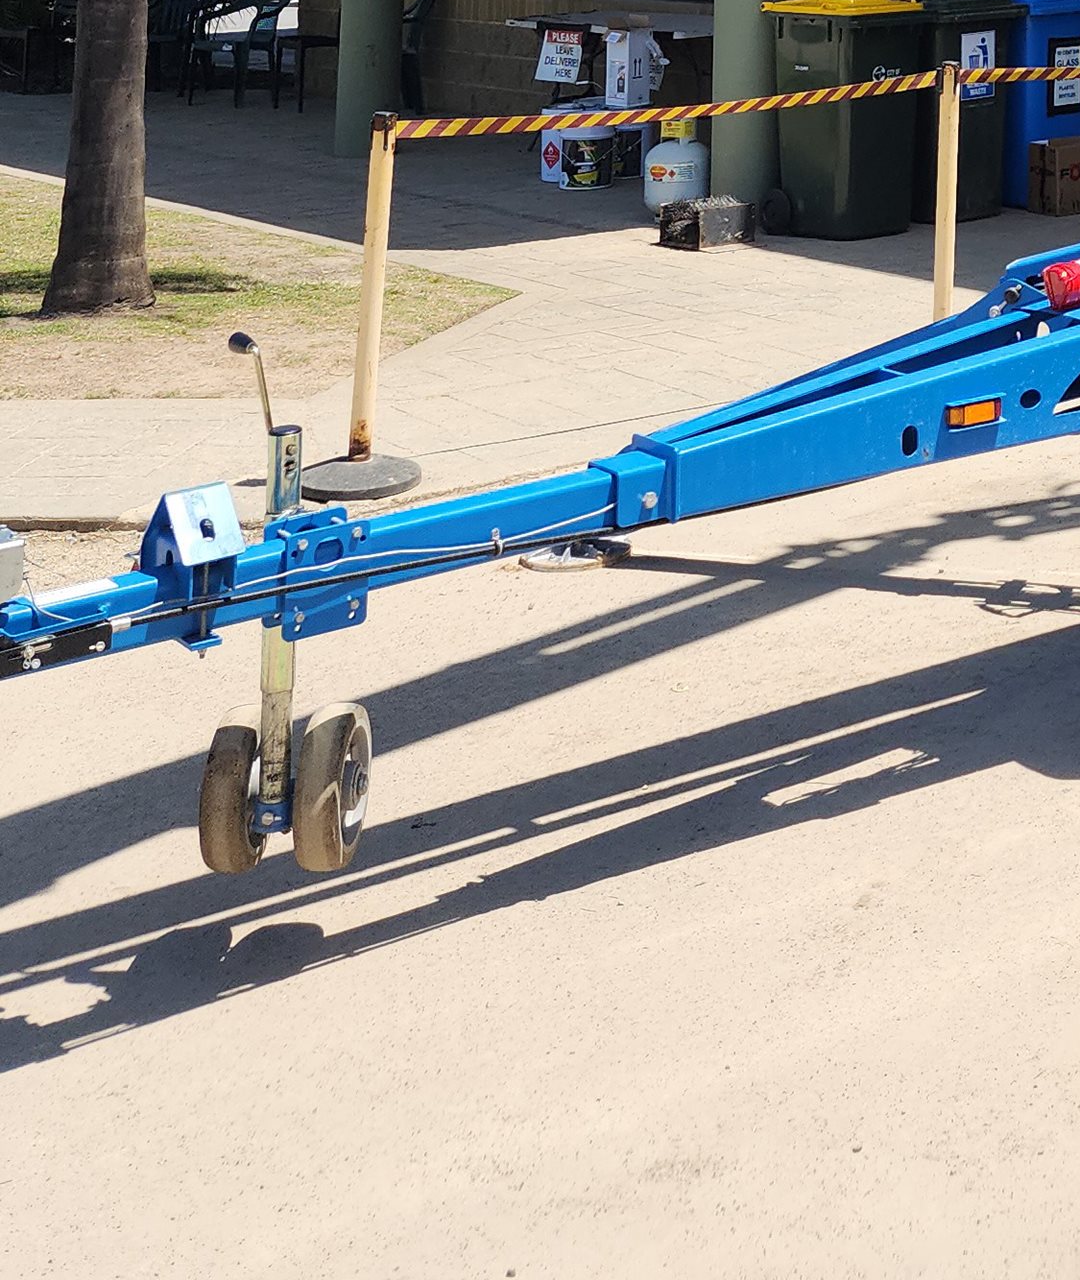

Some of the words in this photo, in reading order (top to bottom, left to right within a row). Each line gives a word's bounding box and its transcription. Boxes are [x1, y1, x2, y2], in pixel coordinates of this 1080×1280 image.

[552, 32, 579, 44] PLEASE
[555, 45, 574, 56] LEAVE
[1057, 57, 1080, 68] GLASS
[555, 68, 572, 78] HERE
